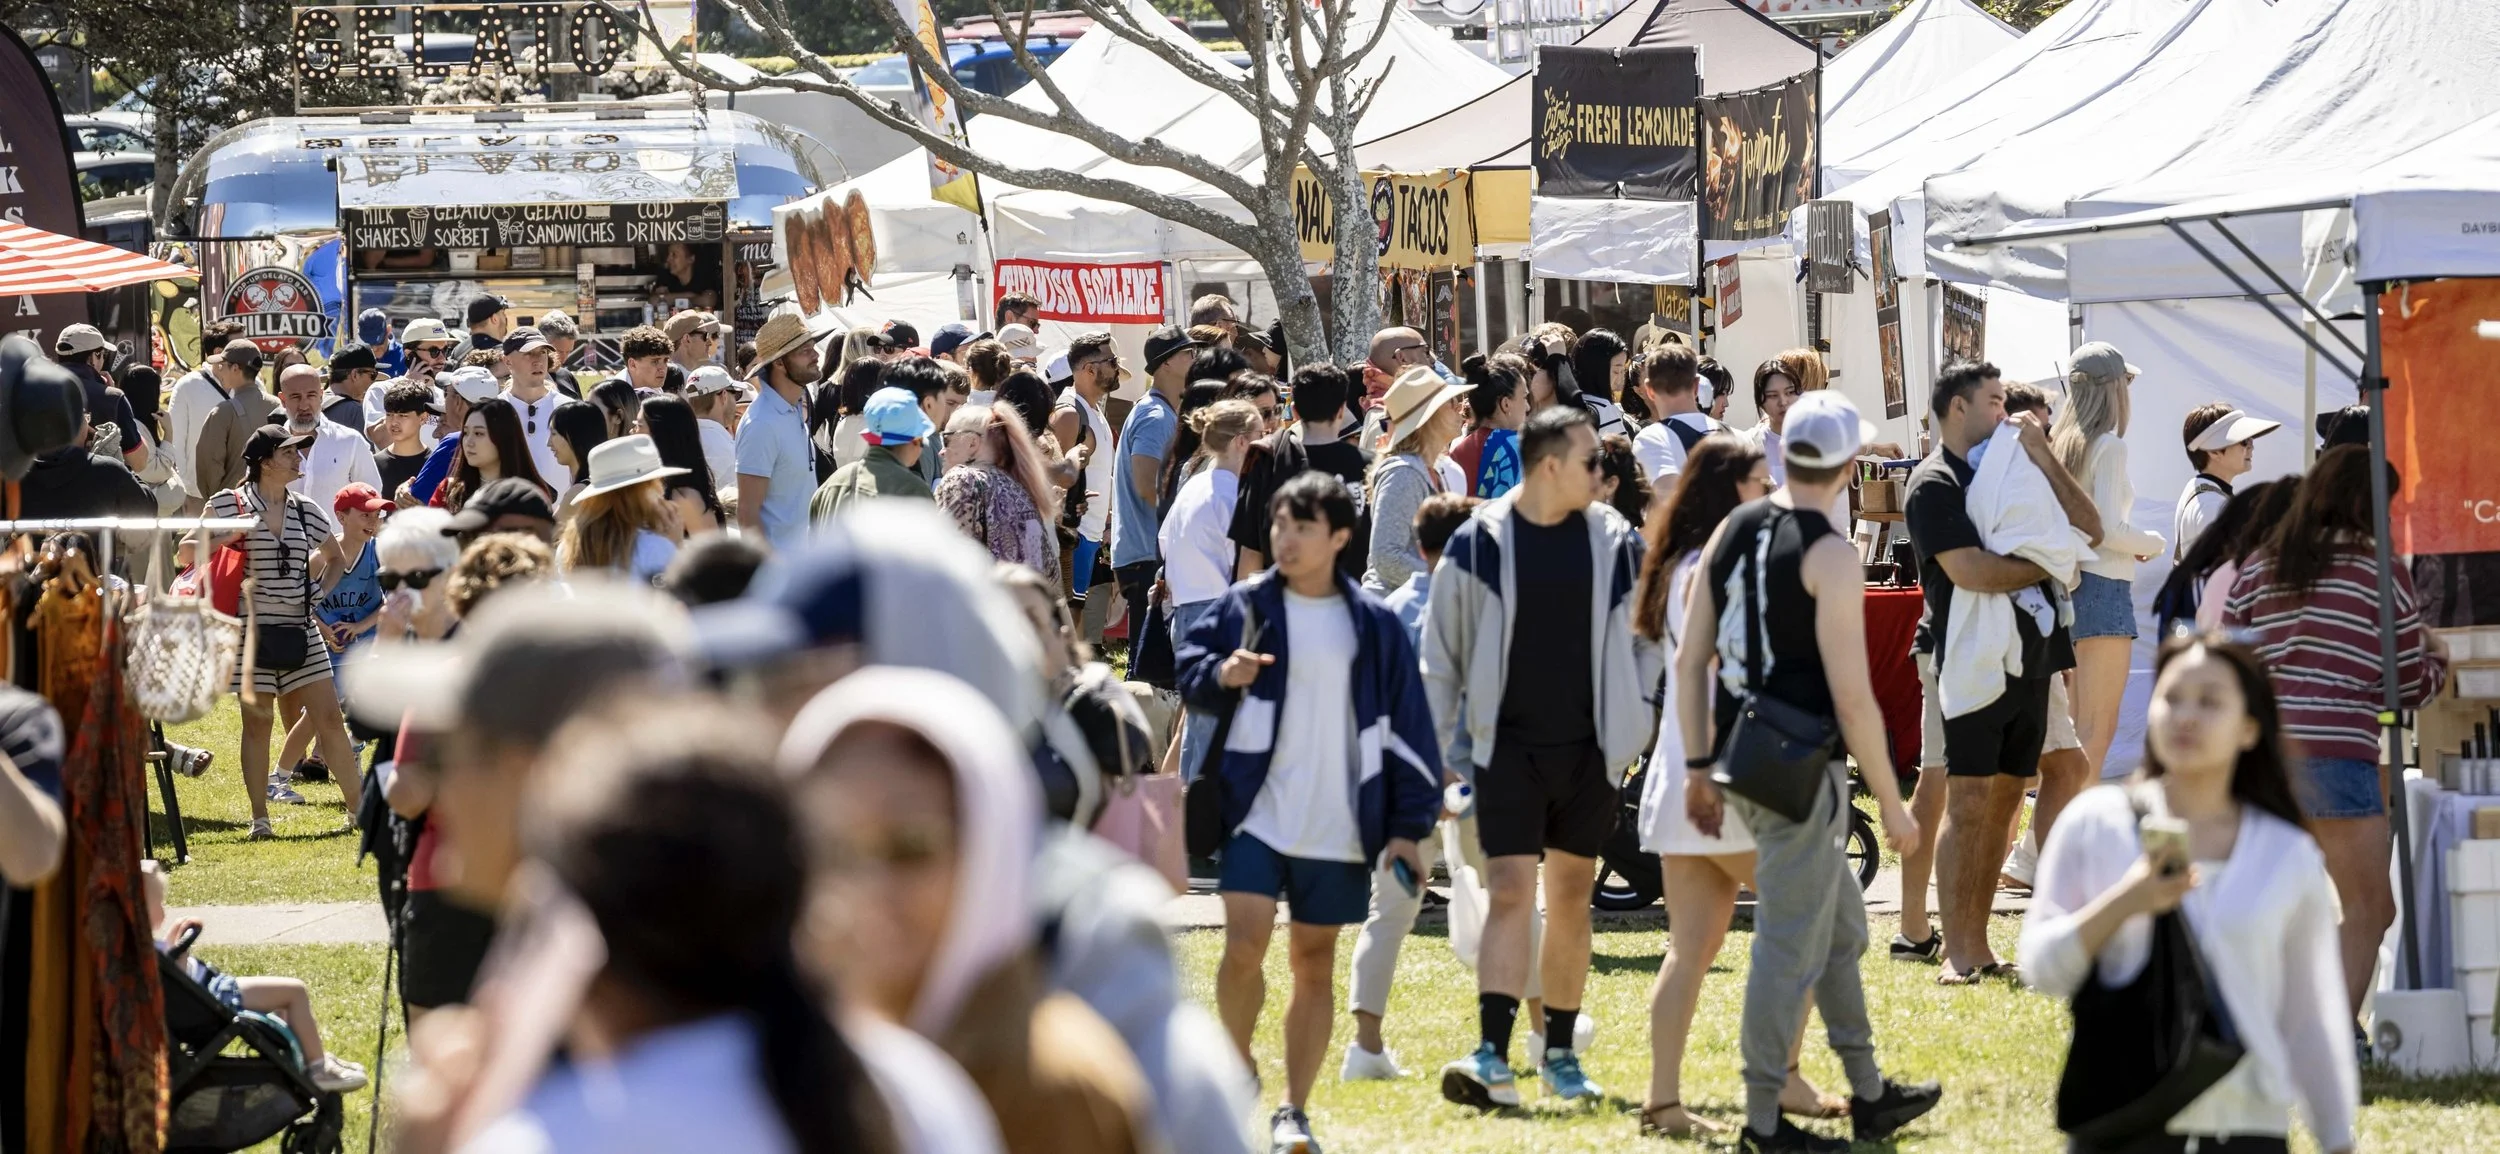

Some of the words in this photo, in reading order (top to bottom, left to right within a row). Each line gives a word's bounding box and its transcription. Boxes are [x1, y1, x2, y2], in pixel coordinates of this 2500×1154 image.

[295, 3, 618, 82] GELATO
[1576, 104, 1621, 145] FRESH
[1627, 105, 1696, 147] LEMONADE
[362, 207, 394, 225] MILK
[434, 205, 491, 222] GELATO
[524, 205, 582, 221] GELATO
[637, 202, 674, 220] COLD
[1399, 184, 1449, 256] TACOS
[457, 220, 466, 229] &
[526, 221, 615, 245] SANDWICHES
[626, 221, 687, 243] DRINKS
[2462, 221, 2500, 234] DAYB
[355, 227, 410, 249] SHAKES
[434, 228, 490, 247] SORBET
[1812, 203, 1846, 269] PAELLA
[234, 275, 260, 297] POP-UP
[262, 272, 294, 283] GELATO
[295, 281, 309, 297] BAR
[1656, 284, 1690, 323] Water
